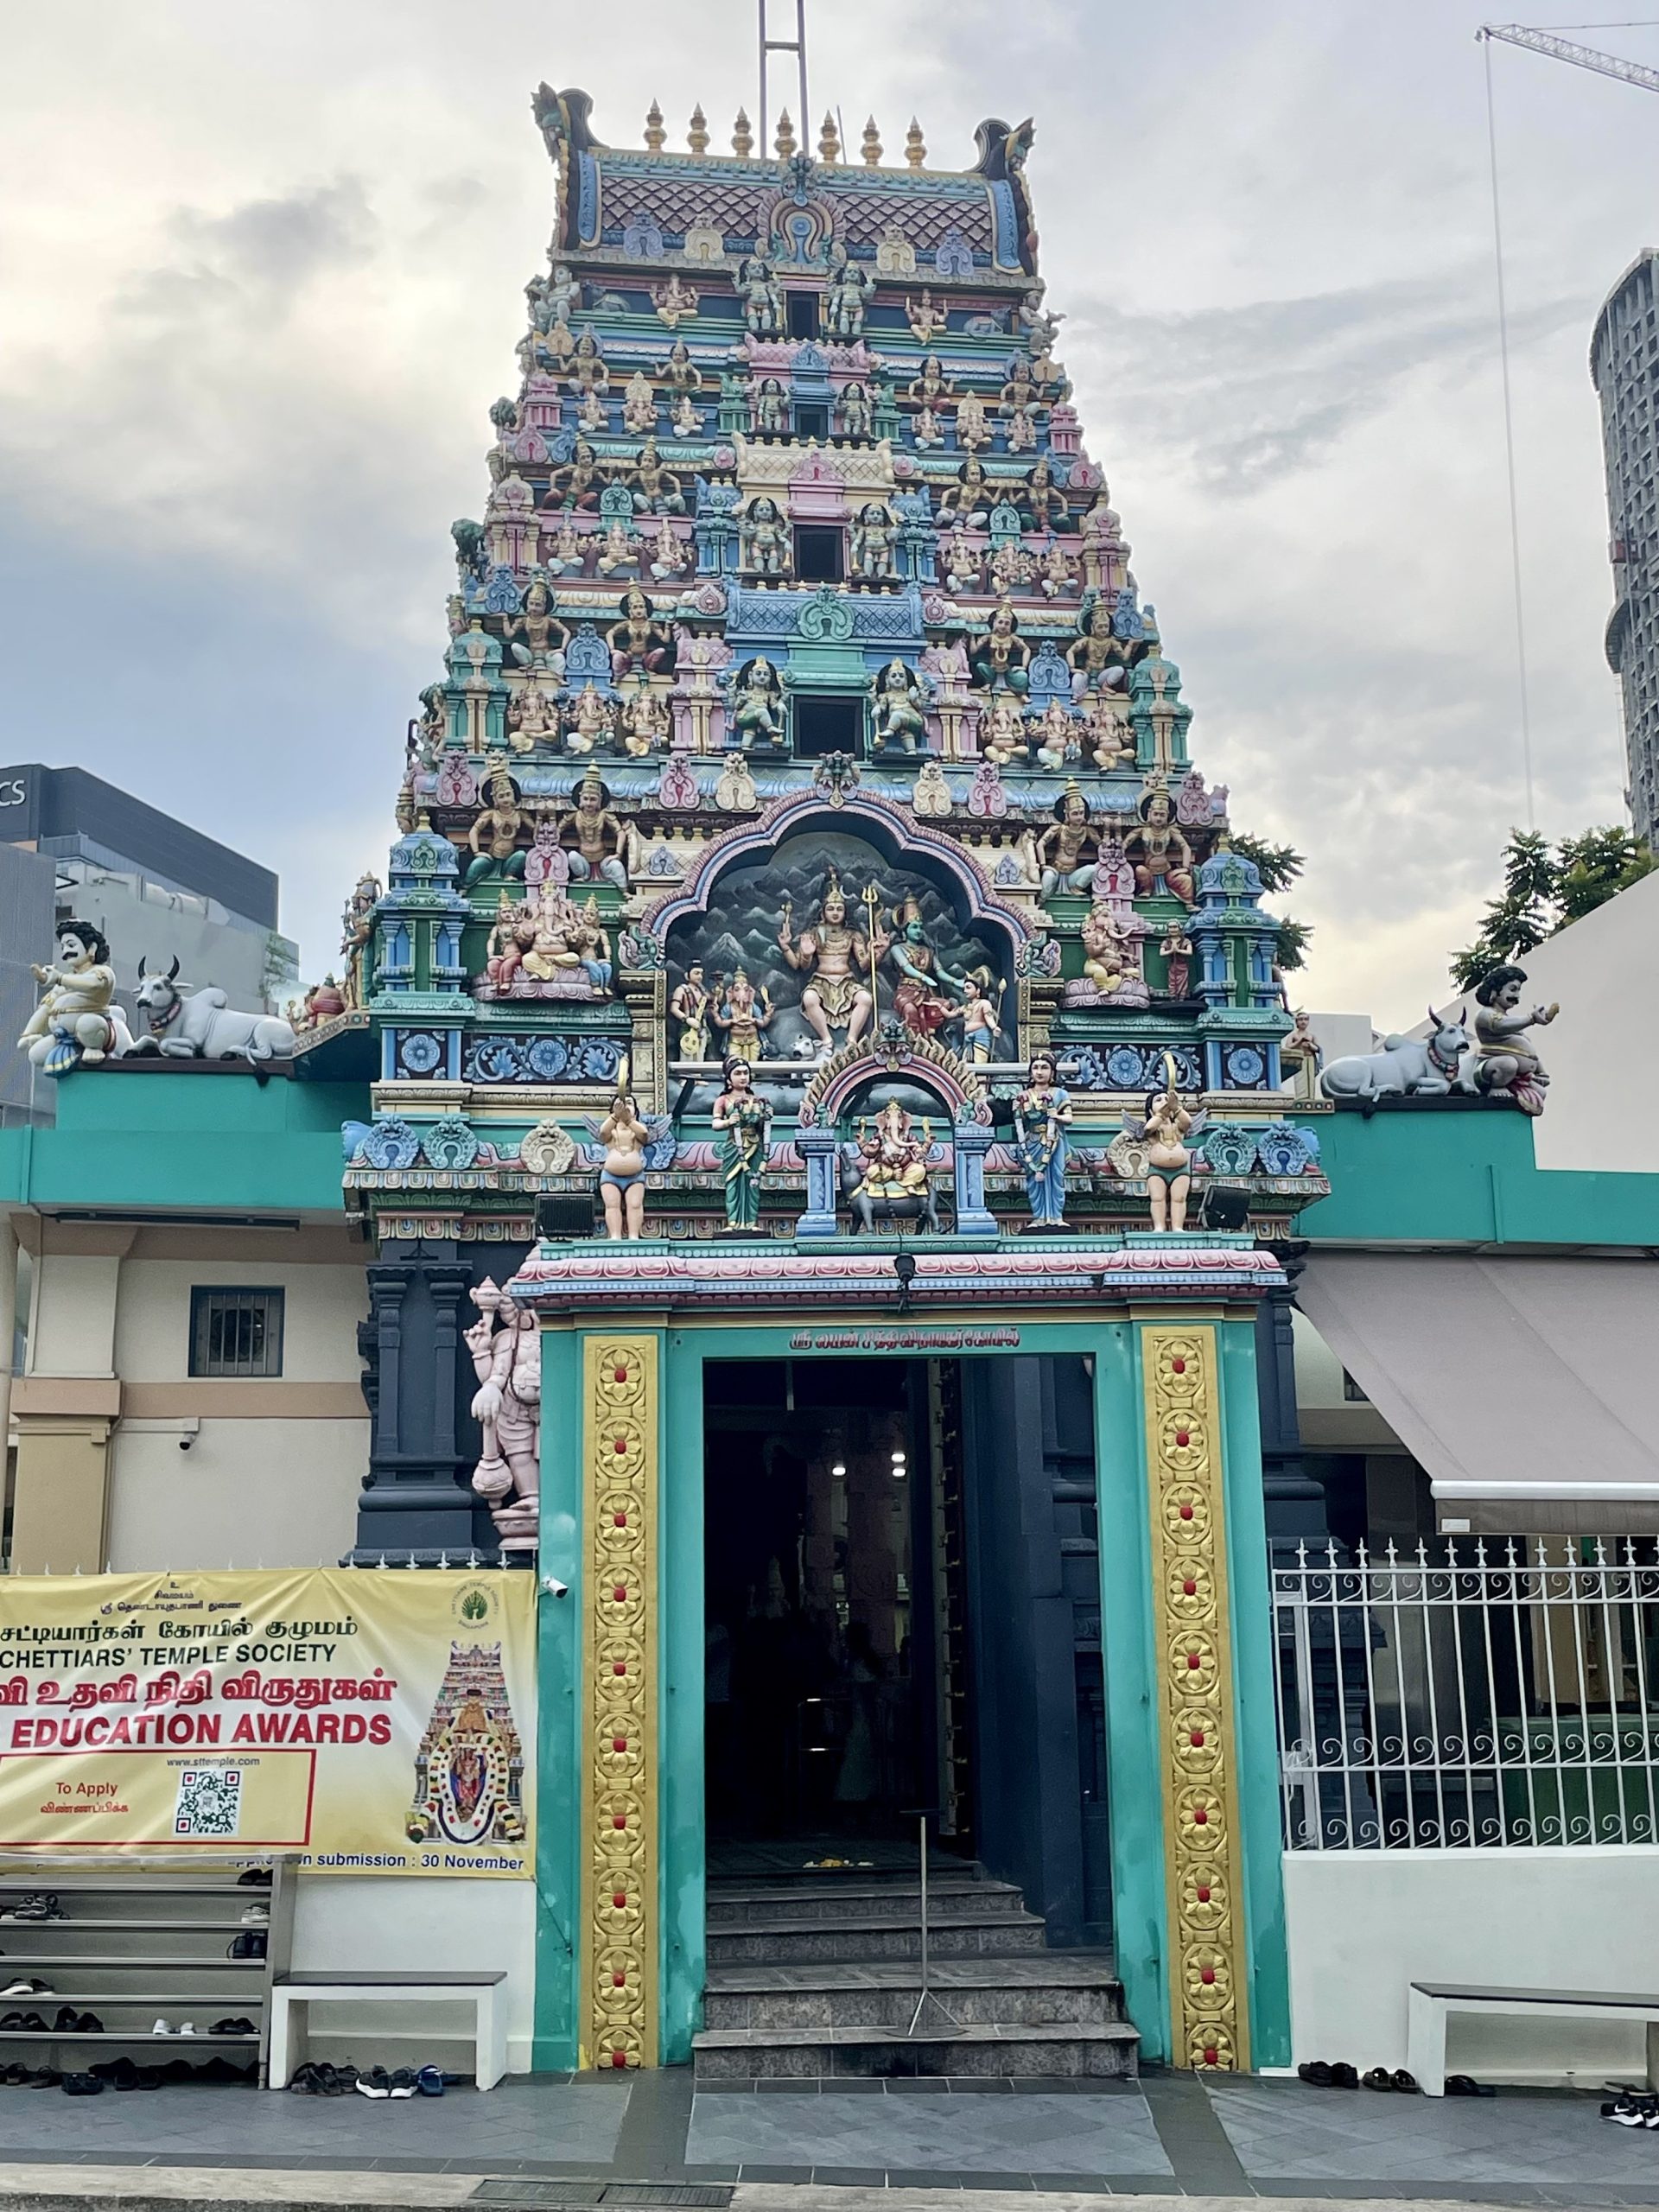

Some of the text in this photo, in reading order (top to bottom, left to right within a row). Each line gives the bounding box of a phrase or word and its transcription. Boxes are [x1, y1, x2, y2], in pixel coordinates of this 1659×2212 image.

[154, 1590, 194, 1599] சிவமயம்
[208, 1602, 243, 1612] துணை
[159, 1617, 253, 1640] கோயில்
[265, 1615, 358, 1641] குழுமம்
[140, 1645, 229, 1666] TEMPLE
[235, 1643, 337, 1663] SOCIETY
[35, 1673, 138, 1713] உதவி
[143, 1670, 213, 1711] நிதி
[221, 1667, 397, 1709] விருதுகள்
[10, 1713, 391, 1749] EDUCATION AWARDS
[167, 1757, 260, 1767] www.sttemple.com
[55, 1782, 118, 1797] To Apply
[40, 1801, 129, 1814] விண்ணப்பிக்க
[317, 1853, 406, 1866] submission
[421, 1854, 439, 1867] 30
[444, 1855, 524, 1870] November
